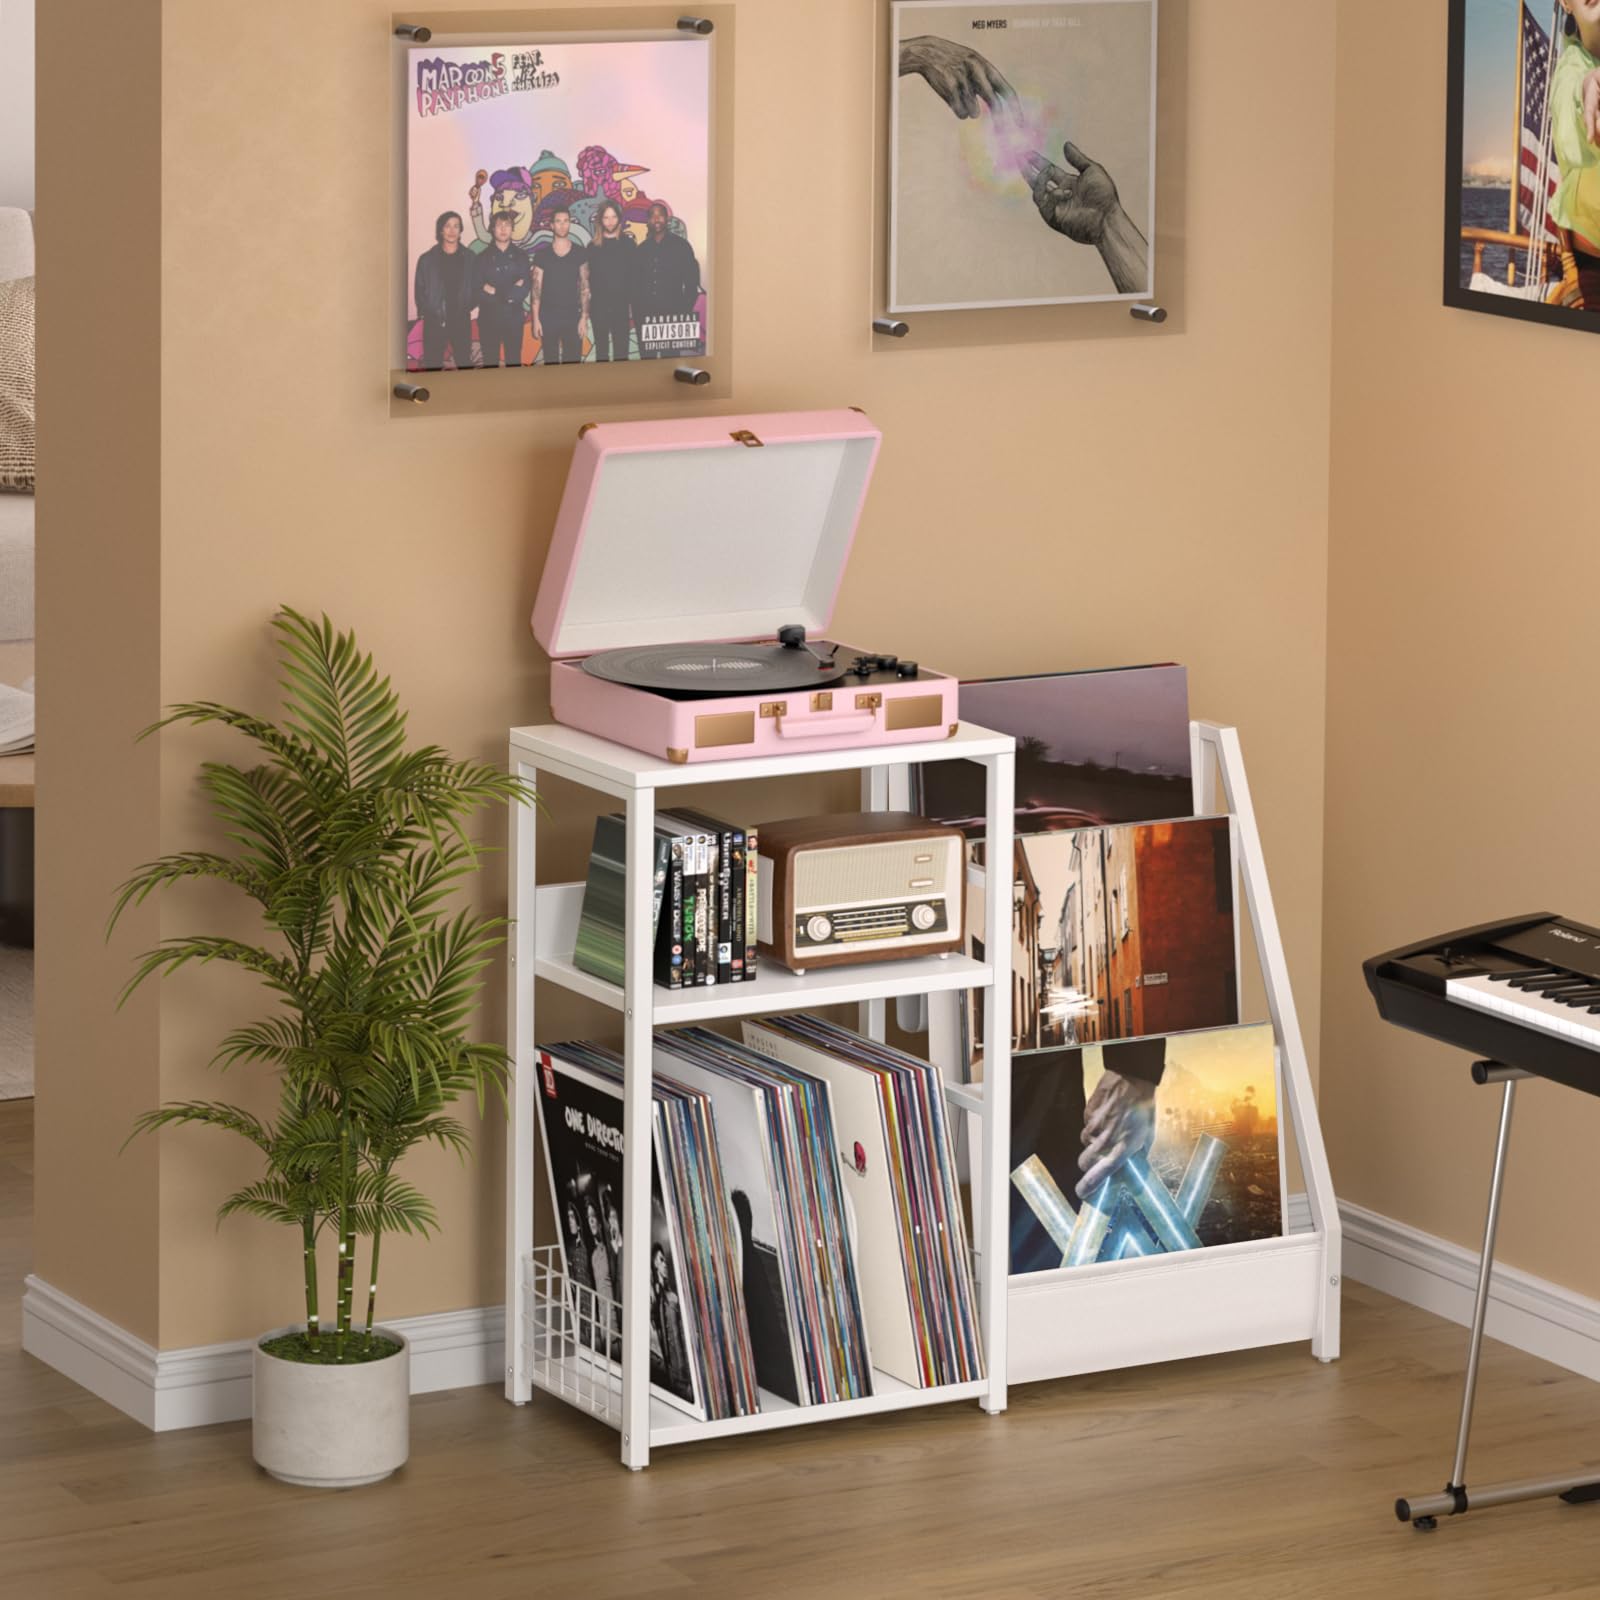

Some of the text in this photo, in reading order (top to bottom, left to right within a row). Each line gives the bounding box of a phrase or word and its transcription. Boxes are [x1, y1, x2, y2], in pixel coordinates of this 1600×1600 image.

[972, 19, 986, 30] MEG
[987, 19, 1008, 30] MYERS
[417, 52, 507, 92] MAROON 5
[417, 79, 509, 117] PAYPHONE
[645, 313, 697, 323] PARENTAL
[644, 323, 697, 340] ADVISORY
[645, 339, 697, 350] EXPLICIT CONTENT
[683, 896, 695, 942] TUROK
[1549, 929, 1588, 943] Roland
[565, 1105, 585, 1134] ONE
[587, 1113, 624, 1155] DIRECTIO
